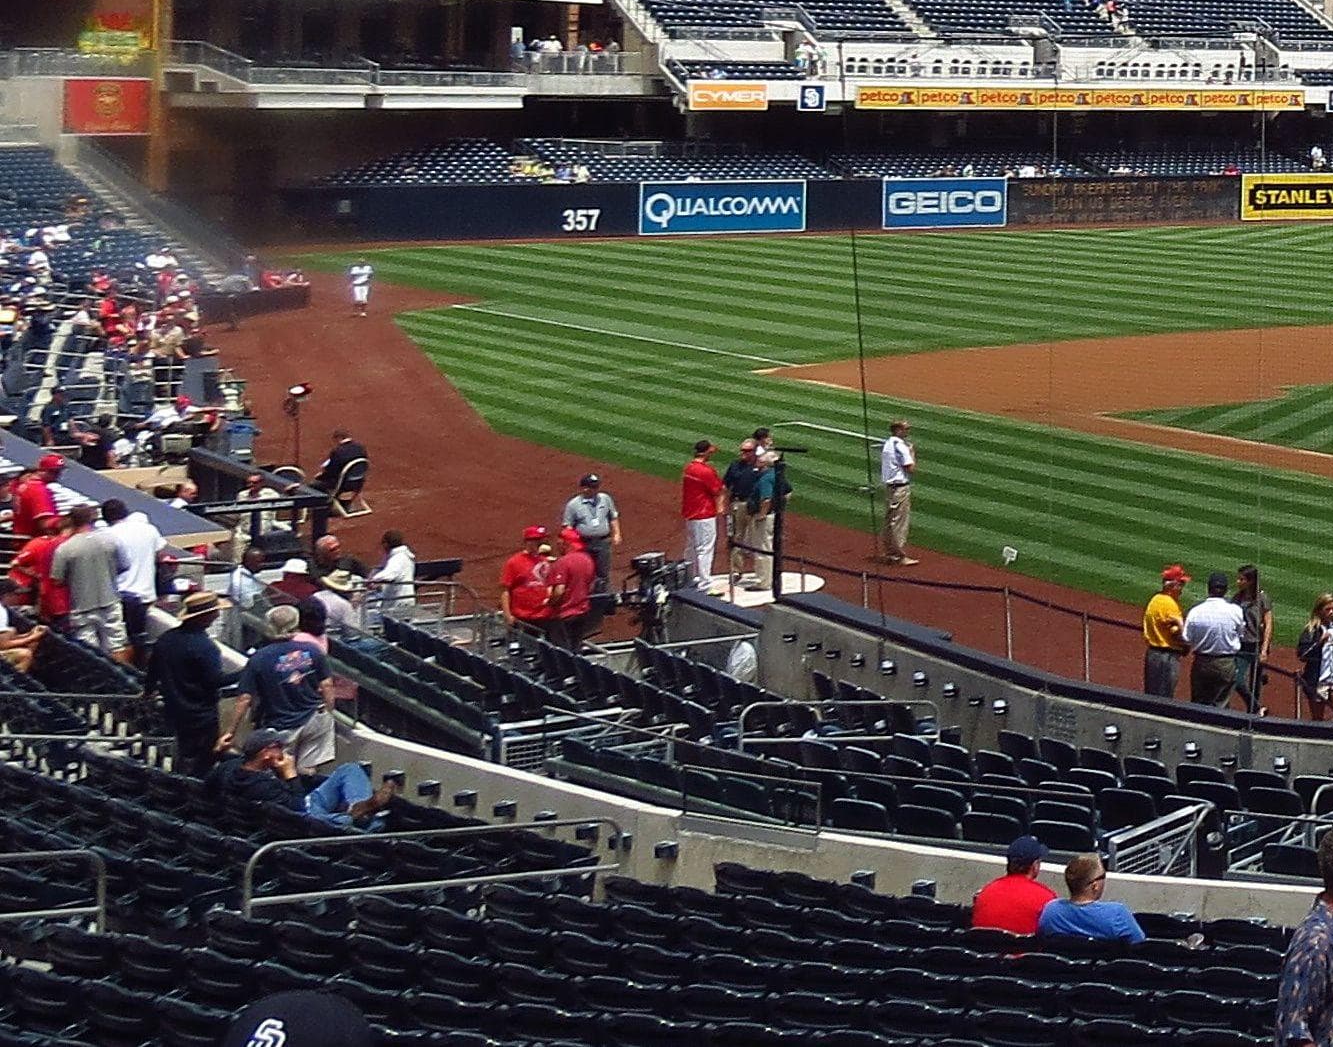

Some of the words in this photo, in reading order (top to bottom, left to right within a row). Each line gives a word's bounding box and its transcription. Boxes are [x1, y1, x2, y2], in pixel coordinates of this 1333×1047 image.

[692, 89, 767, 104] CYMER
[859, 91, 899, 105] petco
[920, 91, 958, 105] petco
[981, 91, 1018, 105] petco
[1040, 91, 1075, 105] petco
[1096, 91, 1131, 105] petco
[1151, 91, 1185, 105] petco
[1204, 92, 1237, 105] petco
[1257, 92, 1288, 105] petco
[645, 192, 800, 228] QUALCOMM
[888, 190, 1003, 215] GEICO
[561, 208, 601, 232] 357
